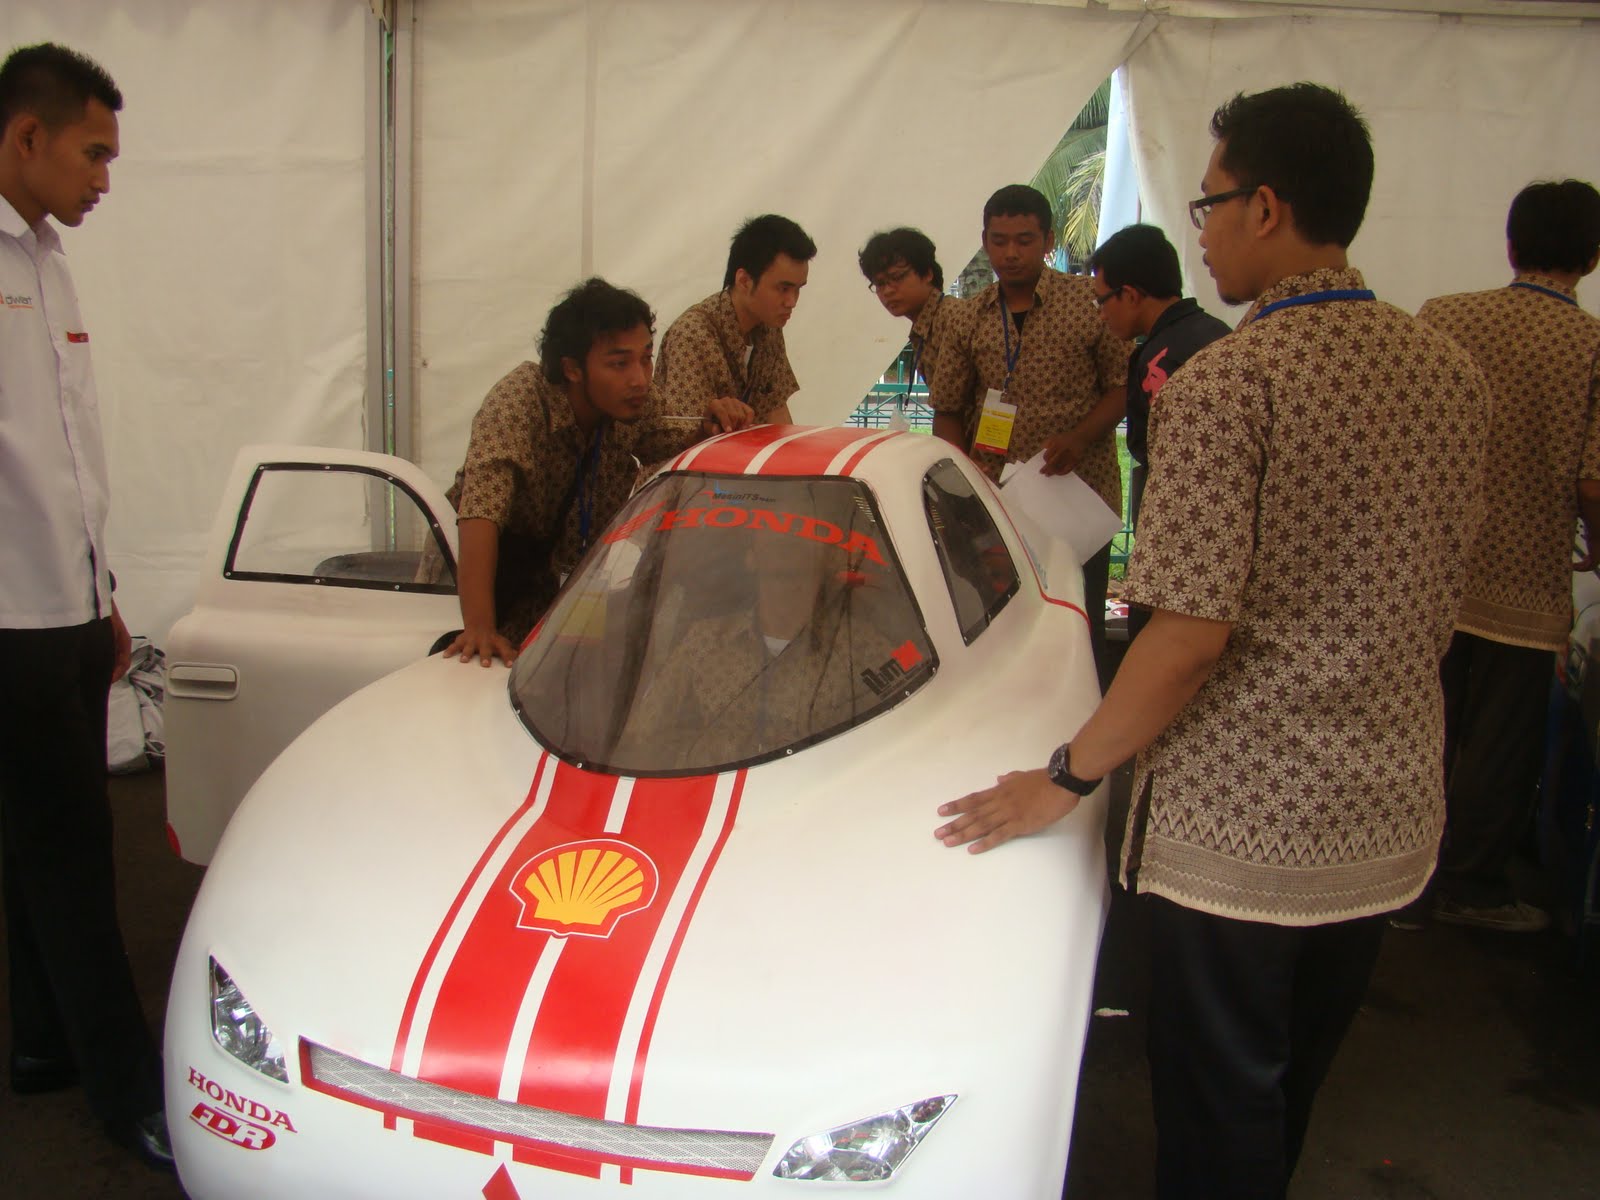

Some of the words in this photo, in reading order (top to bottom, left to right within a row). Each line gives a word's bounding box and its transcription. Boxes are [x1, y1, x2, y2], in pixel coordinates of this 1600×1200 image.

[655, 507, 888, 566] HONDA
[188, 1066, 298, 1134] HONDA
[189, 1102, 276, 1150] FDR
